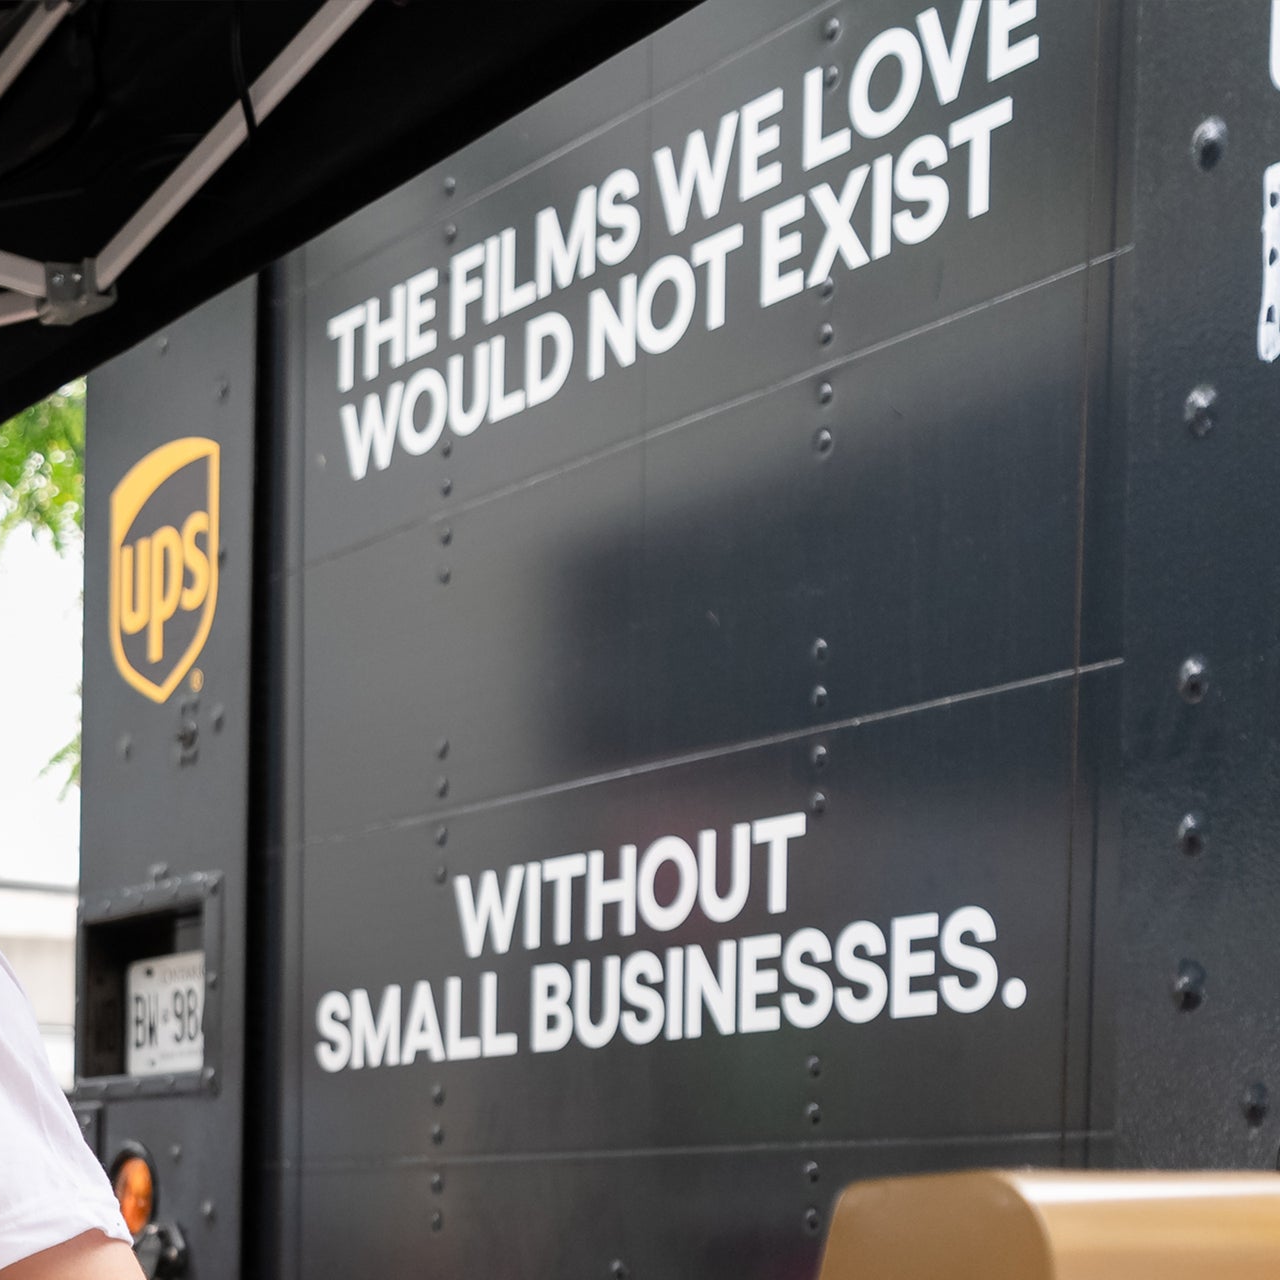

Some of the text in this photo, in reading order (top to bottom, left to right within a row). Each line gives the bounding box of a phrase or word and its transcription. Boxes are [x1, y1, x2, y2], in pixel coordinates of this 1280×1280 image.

[326, 0, 1040, 394] THE FILMS WE LOVE
[340, 95, 1014, 482] WOULD NOT EXIST
[316, 905, 1028, 1072] SMALL BUSINESSES.
[454, 812, 807, 958] WITHOUT
